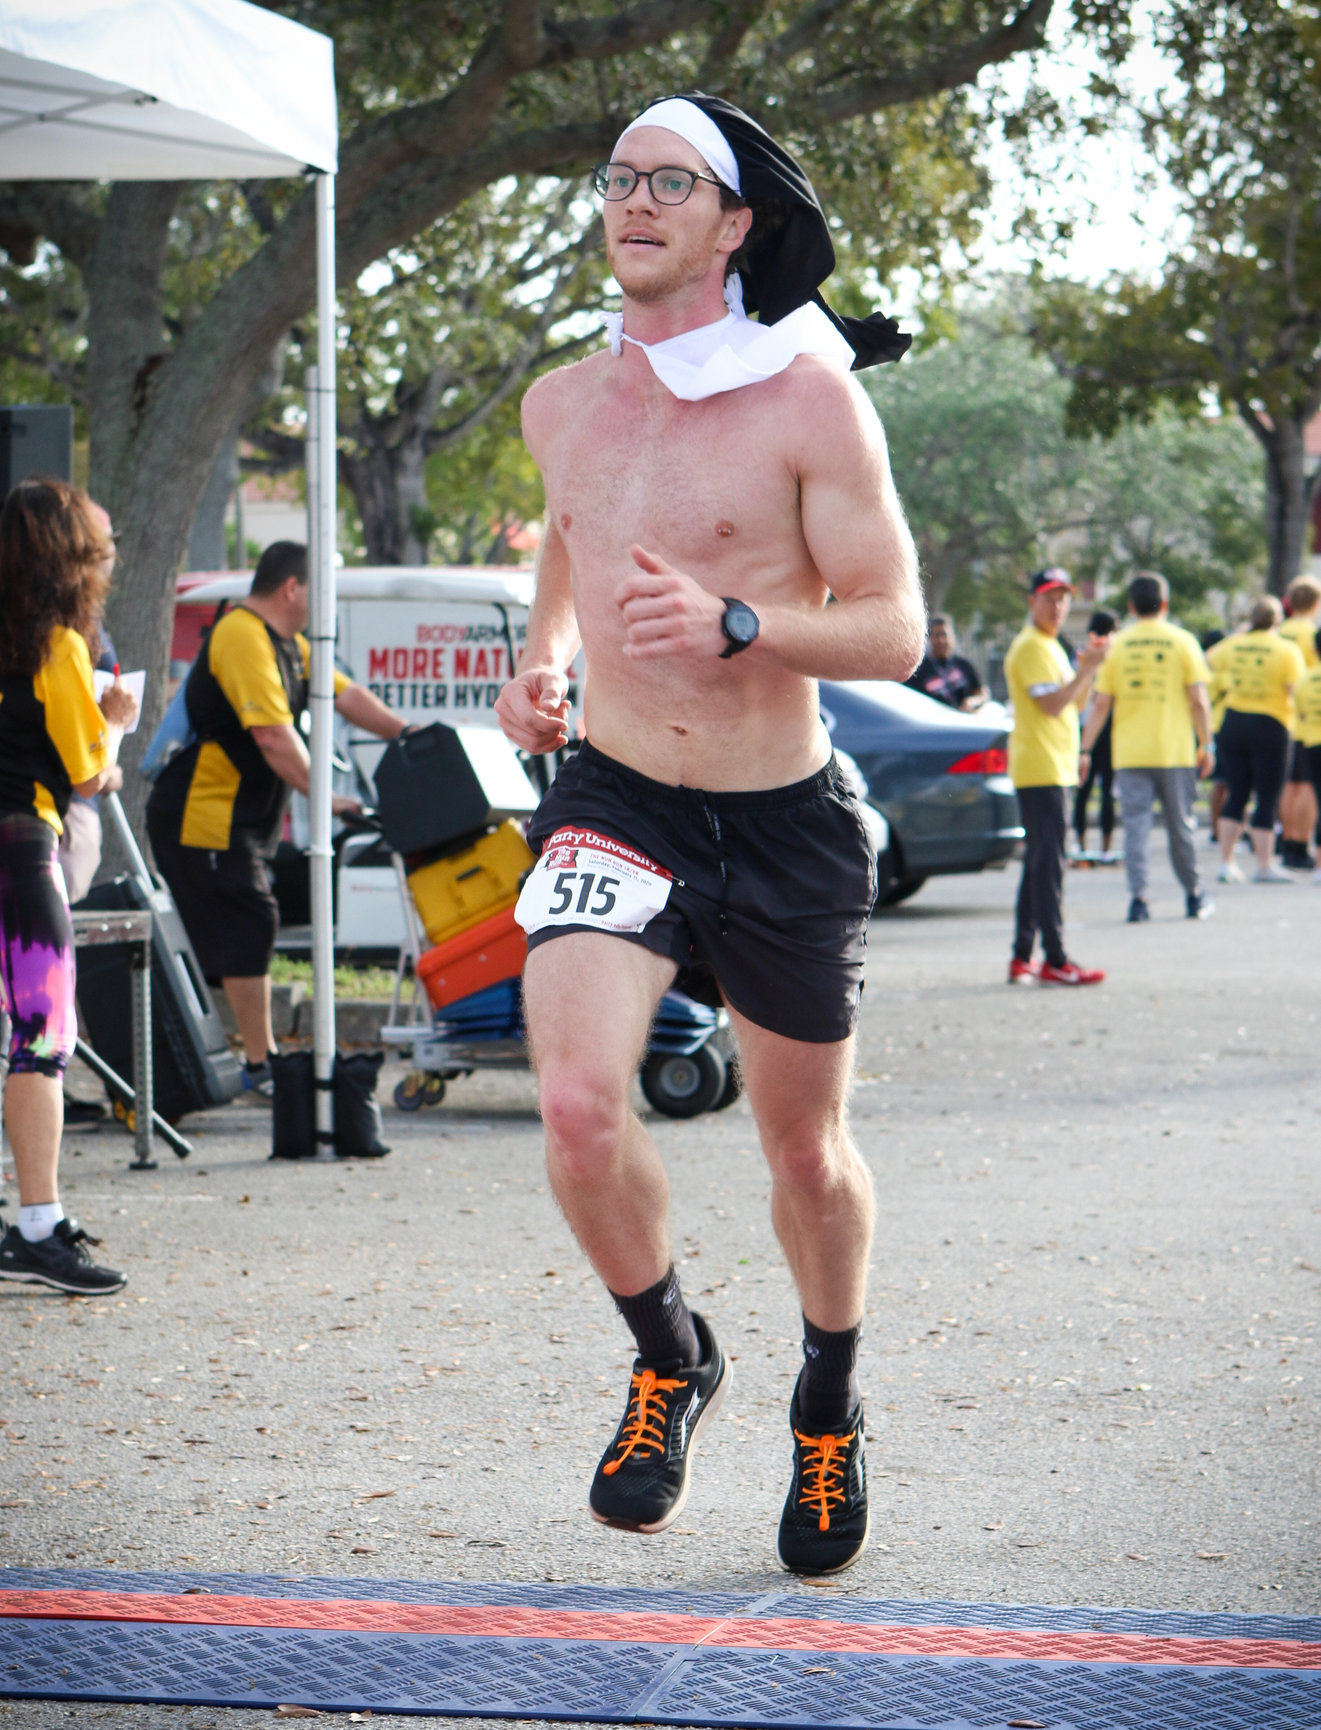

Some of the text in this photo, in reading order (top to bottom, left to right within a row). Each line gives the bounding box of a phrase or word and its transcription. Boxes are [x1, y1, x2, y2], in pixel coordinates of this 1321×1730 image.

[369, 647, 444, 679] MORE
[548, 831, 585, 849] arry
[585, 832, 660, 872] University
[548, 872, 620, 916] 515
